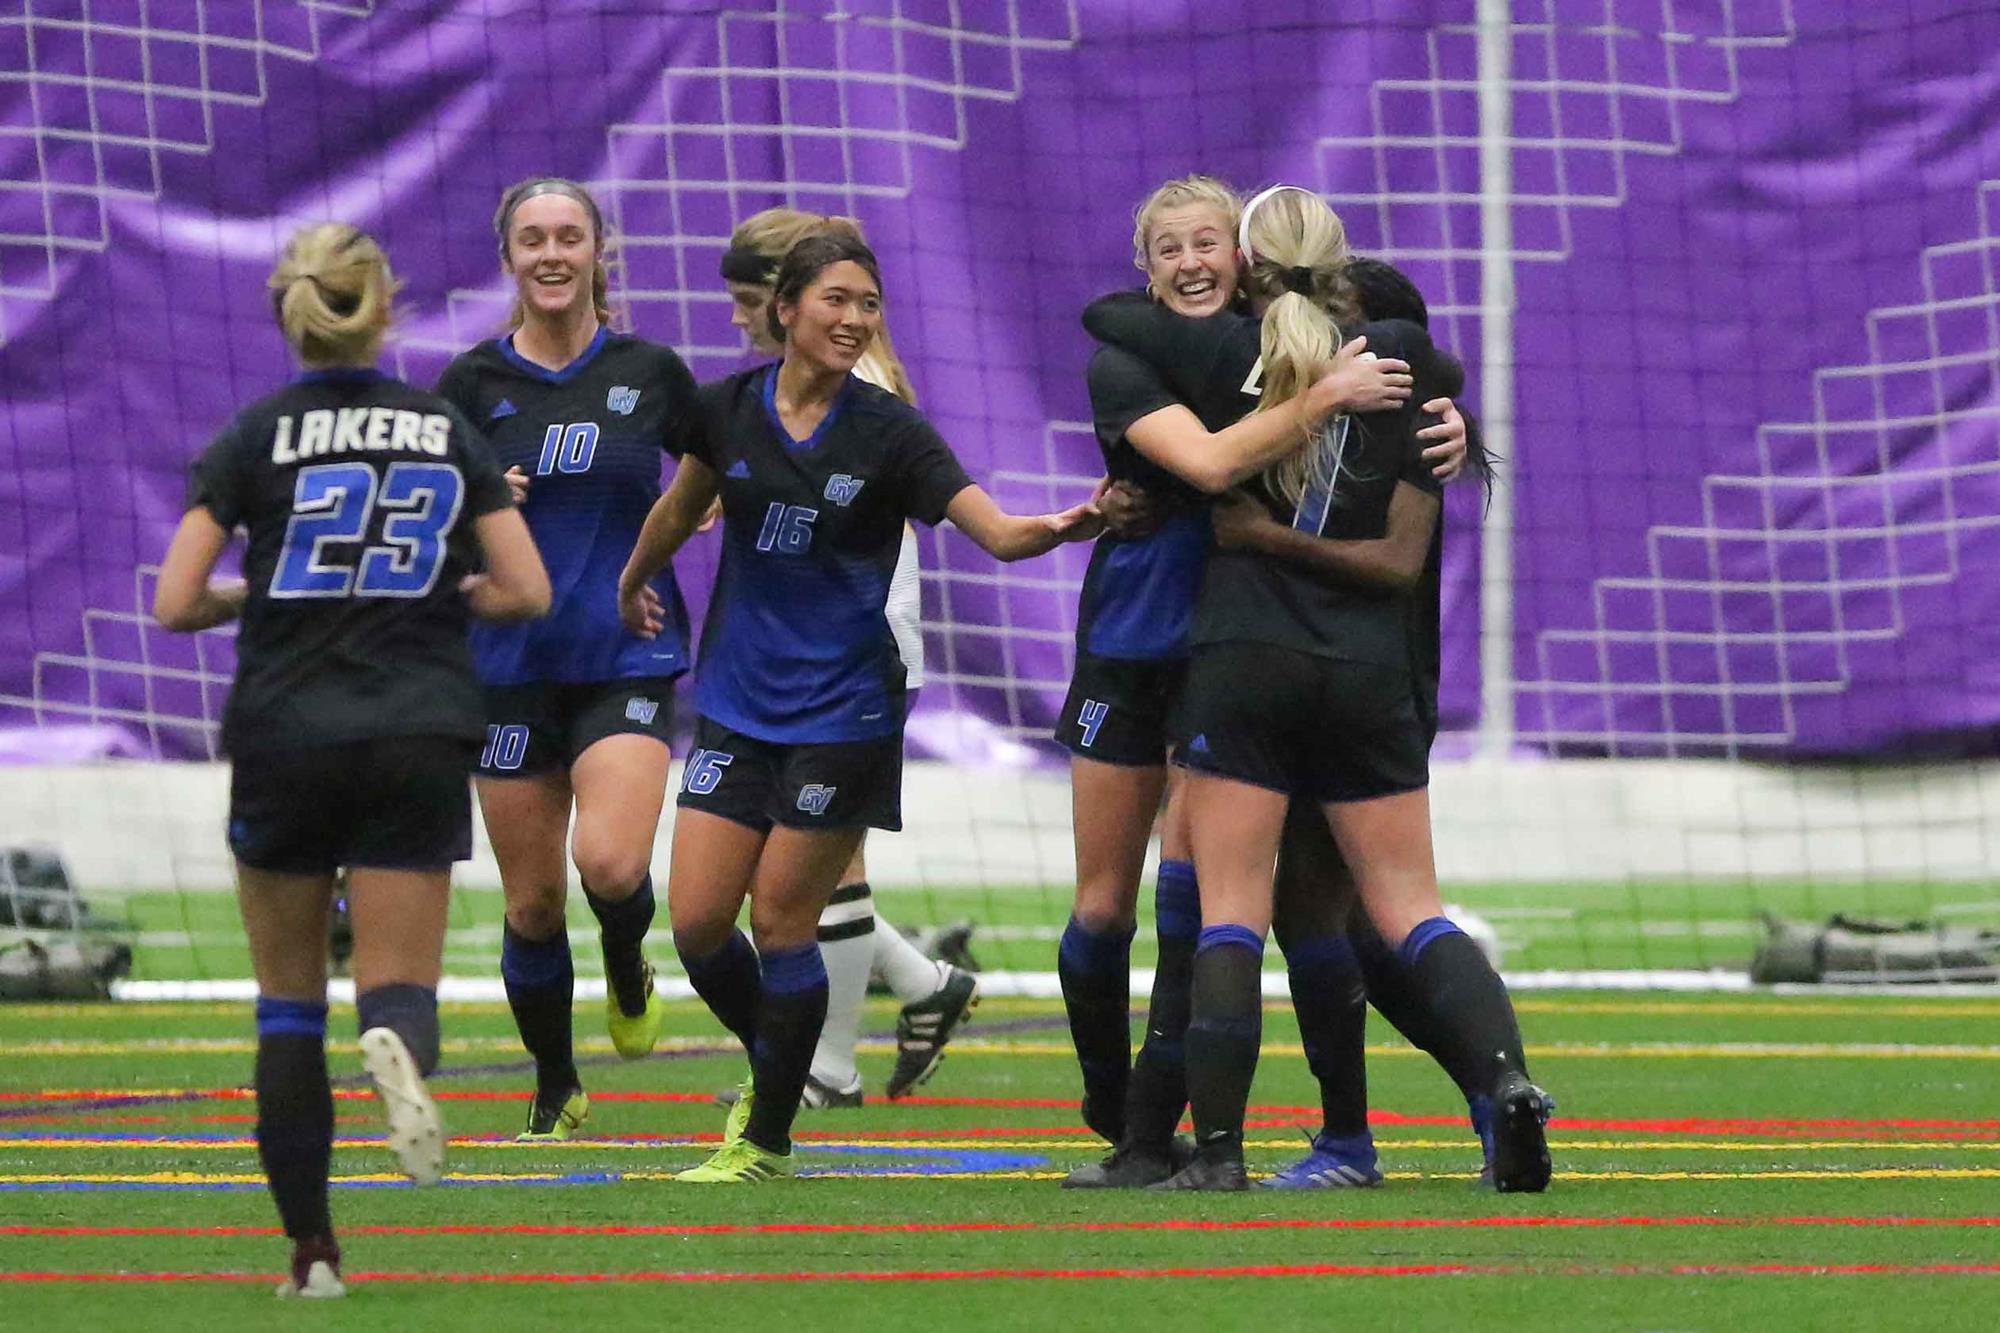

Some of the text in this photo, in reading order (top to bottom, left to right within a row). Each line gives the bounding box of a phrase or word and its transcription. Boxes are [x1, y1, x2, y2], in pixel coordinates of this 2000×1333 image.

[273, 407, 449, 463] LAKERS
[537, 422, 599, 475] 10
[269, 462, 464, 599] 23
[756, 502, 818, 554] 16
[480, 724, 530, 770] 10
[1078, 699, 1109, 747] 4
[680, 749, 734, 795] 16
